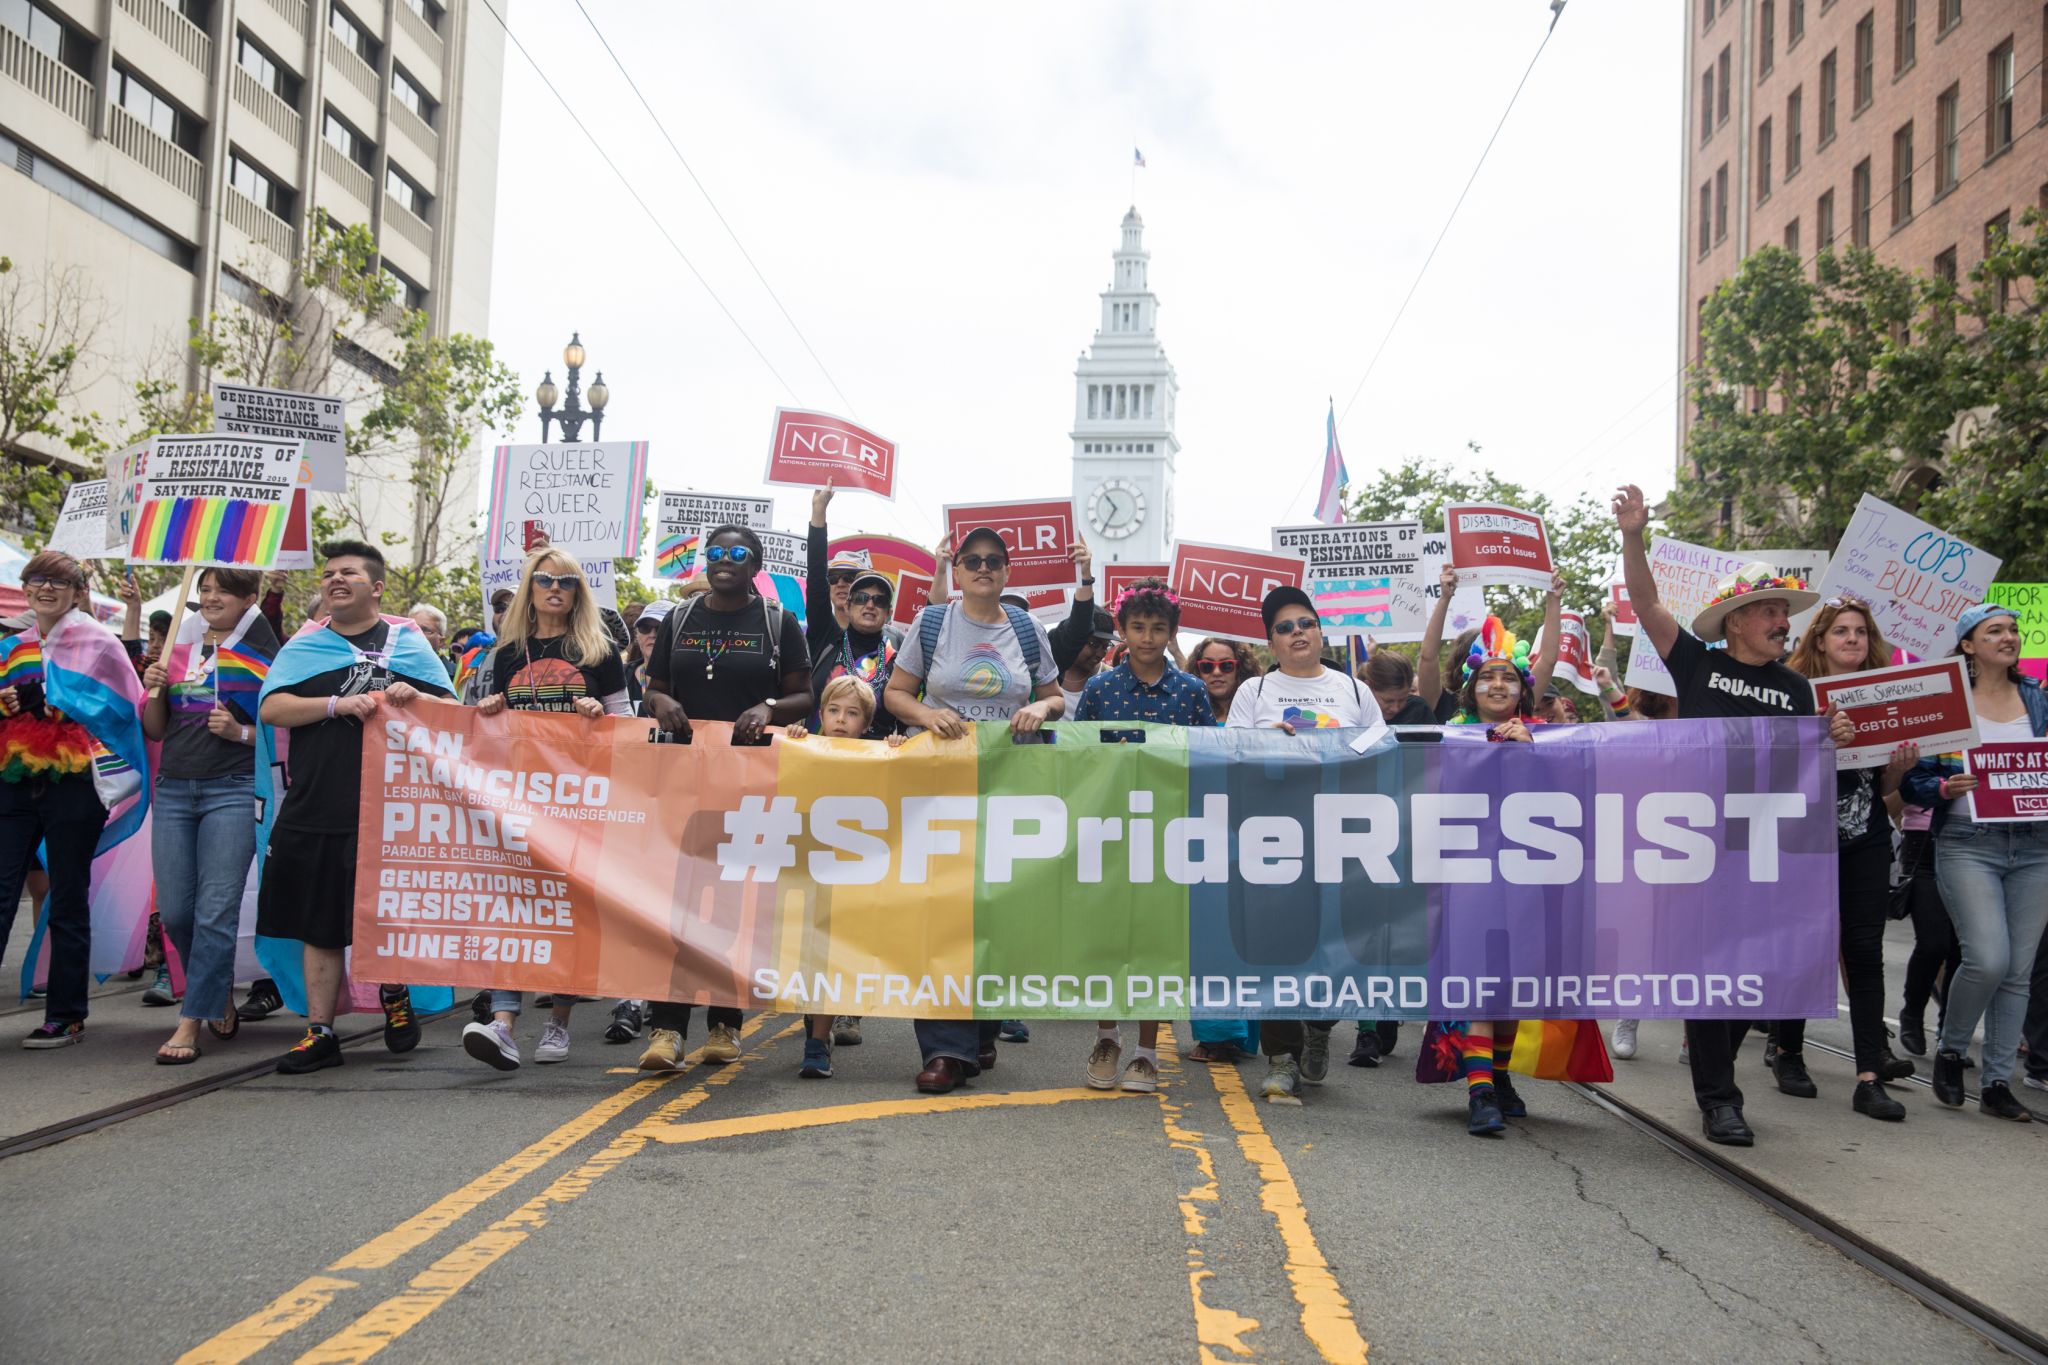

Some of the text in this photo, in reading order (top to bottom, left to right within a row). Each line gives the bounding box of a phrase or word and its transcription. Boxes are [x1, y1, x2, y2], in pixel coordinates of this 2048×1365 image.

[220, 391, 340, 415] GENERATIONS OF
[237, 405, 319, 427] RESISTANCE
[227, 422, 337, 443] SAY THEIR NAME
[156, 444, 296, 462] GENERATIONS OF
[529, 449, 606, 471] QUEER
[791, 430, 879, 468] NCLR
[168, 459, 265, 480] RESISTANCE
[266, 475, 287, 483] 2019
[520, 471, 615, 490] RESISTANCE
[843, 465, 867, 474] LESBIAN
[154, 485, 282, 501] SAY THEIR NAME
[524, 491, 602, 515] QUEER
[665, 497, 769, 514] GENERATIONS OF
[677, 509, 749, 526] RESISTANCE
[1462, 515, 1511, 529] DISABILITY
[667, 525, 688, 535] SAY
[993, 524, 1058, 552] CLR
[1280, 529, 1417, 547] GENERATIONS OF
[1858, 507, 1899, 552] These
[1475, 545, 1537, 559] LGBTQ Issues
[1655, 543, 1710, 569] ABOLISH
[1904, 531, 1974, 583] COPS
[482, 568, 513, 585] SOME
[770, 565, 808, 578] NAME
[1317, 566, 1365, 578] THEIR
[1369, 564, 1414, 576] NAME
[1652, 560, 1706, 586] PROTECT
[1394, 577, 1424, 598] Trans
[1876, 560, 1981, 622] BULLSHIT
[1959, 579, 1983, 597] are
[1206, 604, 1229, 613] CENTER
[1391, 594, 1421, 616] Pride
[1893, 603, 1928, 630] Marsha
[681, 638, 706, 646] LOVE
[728, 639, 758, 647] LOVE
[1884, 622, 1930, 652] Johnson
[1708, 672, 1794, 711] EQUALITY.
[1830, 681, 1924, 705] WHITE SUPREMACY
[957, 705, 1010, 719] BORN
[1886, 706, 1899, 716] =
[1852, 711, 1944, 734] LGBTQ Issues
[385, 719, 464, 761] SAN
[1973, 752, 2025, 769] WHAT'S
[2027, 752, 2042, 768] AT
[384, 752, 610, 807] FRANCISCO
[1991, 772, 2048, 787] TRANS
[384, 785, 443, 801] LESBIAN,
[542, 805, 646, 824] TRANSGENDER
[382, 801, 533, 853] PRIDE
[717, 791, 1807, 885] #SFPrideRESIST
[381, 844, 532, 867] PARADE & CELEBRATION
[379, 869, 568, 898] GENERATIONS OF
[377, 890, 574, 927] RESISTANCE
[377, 933, 552, 965] JUNE 29 30 2019
[752, 968, 1764, 1009] SAN FRANCISCO PRIDE BOARD OF DIRECTORS
